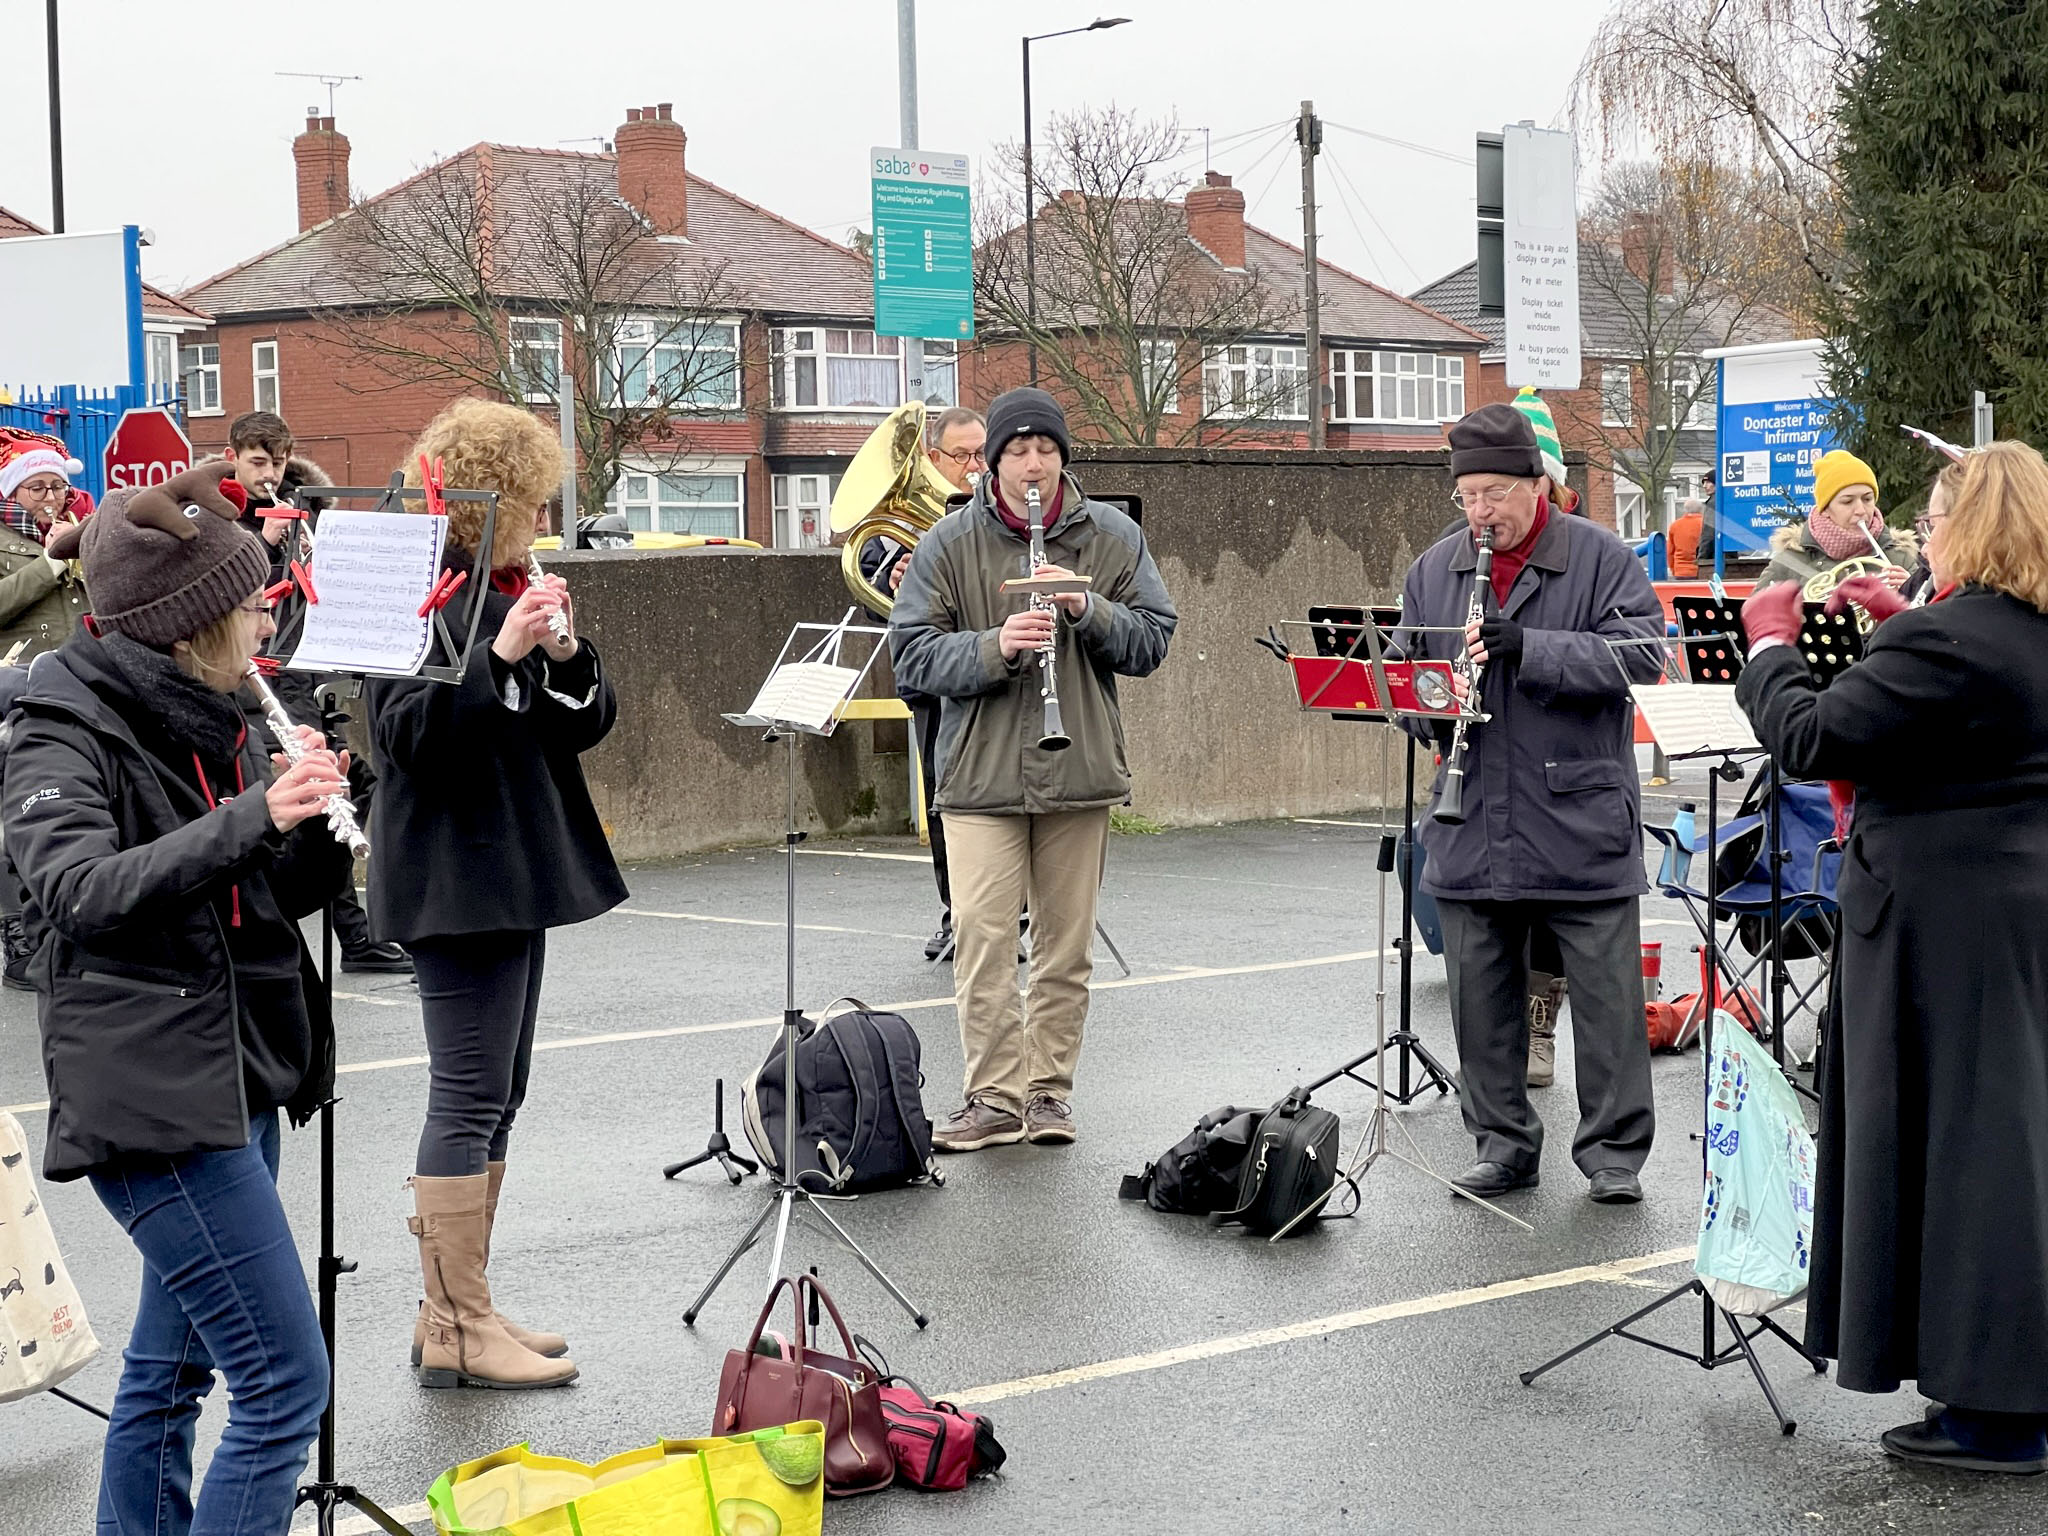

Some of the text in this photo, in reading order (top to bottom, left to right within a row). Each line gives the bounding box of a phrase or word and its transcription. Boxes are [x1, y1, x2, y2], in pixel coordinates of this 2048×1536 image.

[876, 155, 911, 175] saba
[1514, 241, 1526, 250] This
[1544, 244, 1554, 254] pay
[1558, 246, 1569, 254] and
[1516, 254, 1566, 267] display car park
[1521, 275, 1563, 287] Pay at meter
[1521, 297, 1564, 309] Display ticket
[1534, 310, 1552, 320] inside
[1526, 323, 1561, 332] windscreen
[1518, 343, 1569, 355] At busy periods
[1528, 355, 1561, 368] find space
[1538, 369, 1551, 378] first
[1774, 401, 1812, 412] Welcome to
[1744, 414, 1804, 431] Doncaster
[1764, 428, 1820, 445] Infirmary
[1775, 452, 1796, 463] Gate
[110, 460, 188, 490] STOP
[1734, 486, 1760, 498] South
